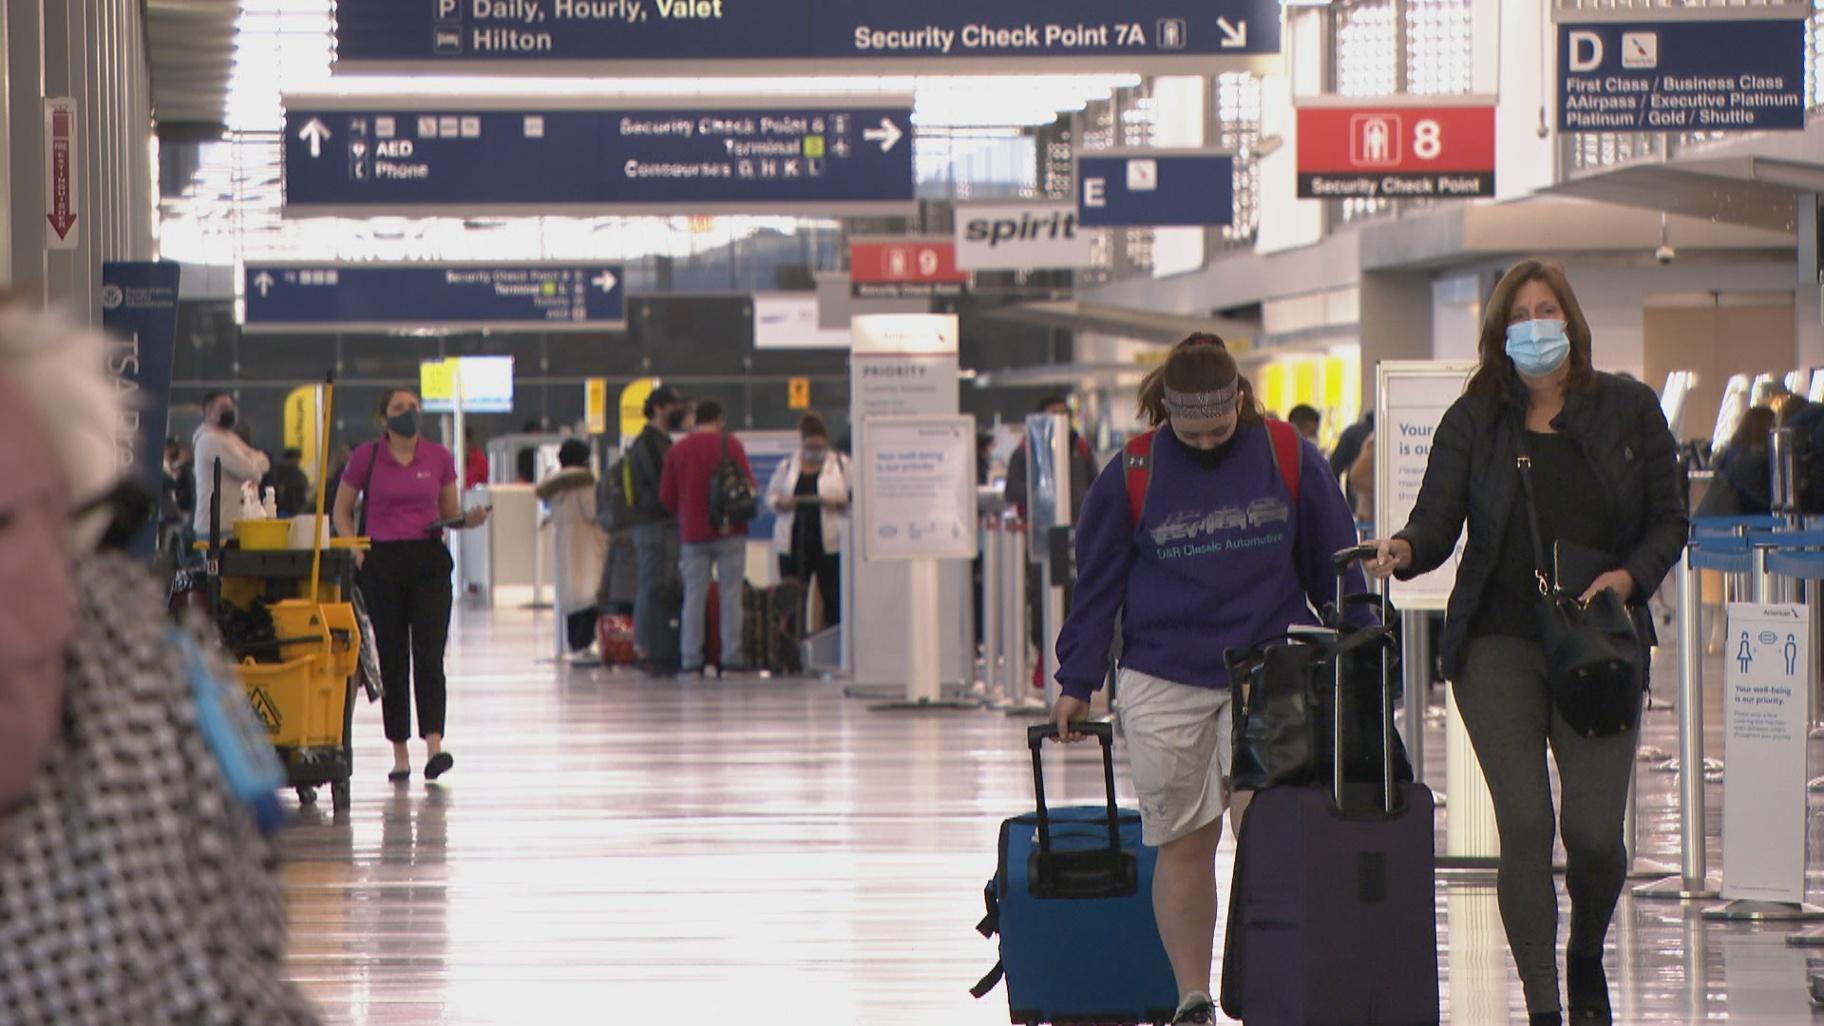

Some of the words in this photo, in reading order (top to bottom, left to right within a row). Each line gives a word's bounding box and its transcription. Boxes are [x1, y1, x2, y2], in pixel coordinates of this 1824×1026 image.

[473, 0, 545, 23] Daily,
[554, 0, 648, 23] Hourly,
[656, 0, 723, 19] Valet
[472, 29, 552, 51] Hilton
[854, 26, 954, 53] Security
[961, 23, 1039, 47] Check
[1045, 23, 1108, 47] Point
[1114, 23, 1145, 46] 7A
[1568, 31, 1604, 72] D
[1566, 77, 1601, 93] First
[1605, 76, 1649, 92] Class
[1663, 75, 1735, 91] Business
[1740, 74, 1784, 90] Class
[1566, 94, 1637, 111] AAirpass
[1651, 92, 1725, 109] Executive
[1730, 91, 1798, 107] Platinum
[619, 116, 695, 138] Security
[699, 116, 755, 135] Check
[759, 115, 808, 136] Point
[1566, 110, 1634, 127] Platinum
[1649, 109, 1686, 124] Gold
[1699, 108, 1755, 124] Shuttle
[375, 140, 414, 158] AED
[723, 139, 801, 156] Terminal
[1413, 119, 1442, 160] 8
[374, 160, 430, 180] Phone
[624, 159, 732, 178] Concourses
[783, 160, 801, 177] K
[1083, 177, 1106, 207] E
[1310, 176, 1378, 196] Security
[1381, 176, 1433, 194] Check
[1437, 176, 1480, 194] Point
[965, 211, 1079, 248] spirit
[918, 248, 938, 277] 9
[1399, 423, 1434, 438] Your
[1399, 442, 1411, 456] is
[1414, 445, 1432, 456] ou
[1183, 541, 1222, 556] Classic
[1224, 533, 1283, 551] Automotive
[1735, 685, 1752, 693] Your
